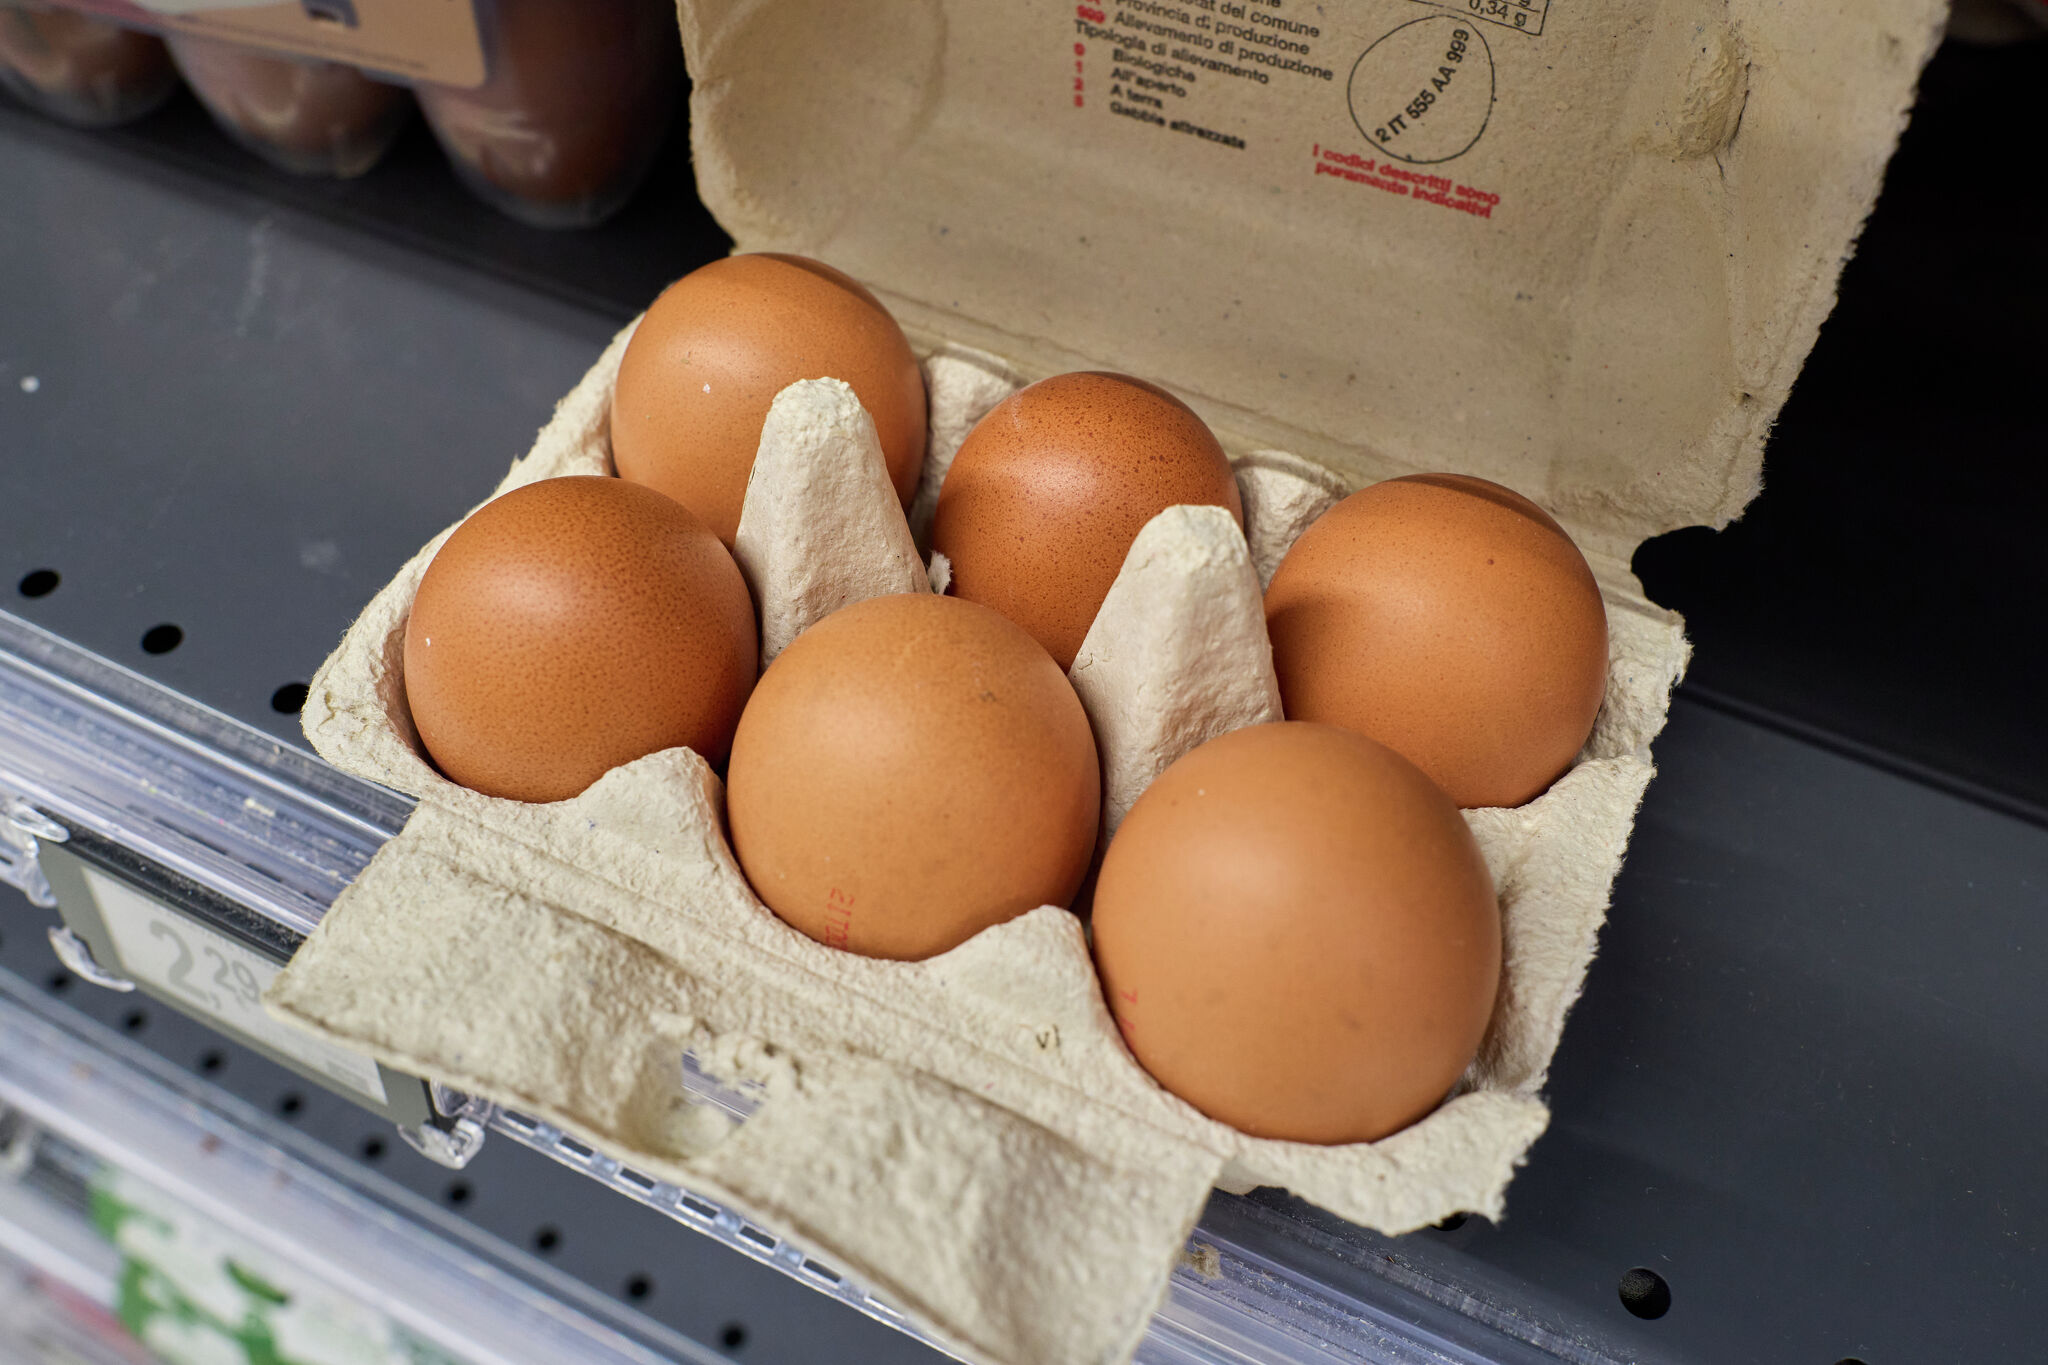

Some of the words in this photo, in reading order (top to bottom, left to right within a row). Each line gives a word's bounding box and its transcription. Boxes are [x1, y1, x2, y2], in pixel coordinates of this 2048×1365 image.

[1220, 2, 1246, 19] del
[1251, 11, 1320, 37] comune
[1469, 0, 1508, 19] 0,34
[1515, 12, 1527, 26] g
[1074, 19, 1146, 51] Tipologia
[1151, 42, 1167, 56] di
[1171, 48, 1269, 84] allevamento
[1115, 11, 1213, 49] Allevamento
[1218, 40, 1234, 55] di
[1238, 47, 1333, 81] produzione
[1215, 22, 1310, 55] produzione
[1113, 48, 1196, 83] Biologiche
[1375, 127, 1392, 143] 2
[1388, 114, 1407, 135] IT
[1405, 89, 1436, 119] 555
[1431, 66, 1456, 93] AA
[1446, 29, 1469, 63] 999
[1110, 84, 1123, 98] A
[1127, 89, 1163, 109] terra
[1313, 143, 1319, 157] I
[1323, 150, 1375, 171] codici
[1379, 164, 1452, 193] descritti
[1455, 185, 1500, 205] sono
[1315, 162, 1408, 195] puramente
[1412, 186, 1492, 219] indicativi
